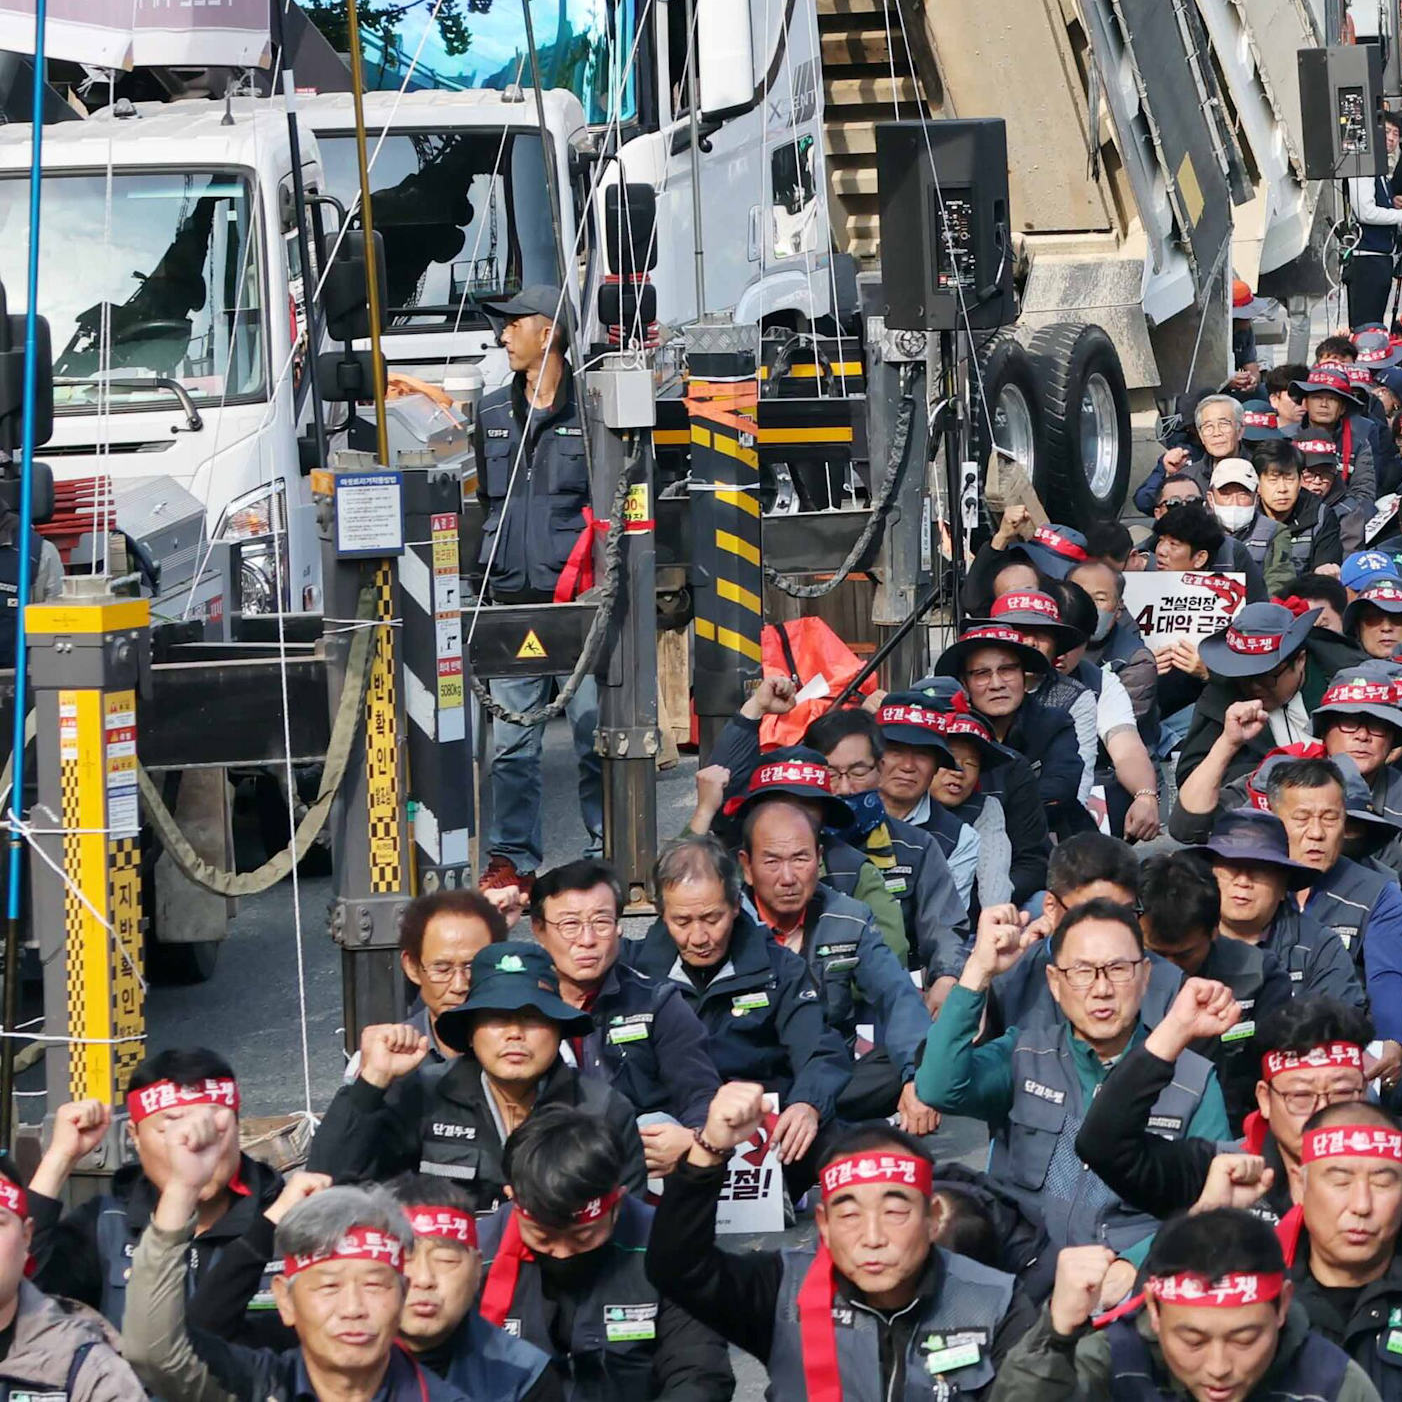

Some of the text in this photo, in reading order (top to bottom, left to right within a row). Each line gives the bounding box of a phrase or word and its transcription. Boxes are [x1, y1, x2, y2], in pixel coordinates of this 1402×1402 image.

[1160, 595, 1217, 613] 건설현장
[1246, 634, 1273, 652] 투쟁
[440, 684, 462, 697] 5080kg
[882, 707, 904, 721] 단결
[760, 765, 827, 785] 단결 투쟁
[1267, 1042, 1361, 1074] 단결 투쟁
[140, 1079, 236, 1113] 단결 투쟁
[1023, 1078, 1066, 1105] 단결투쟁
[432, 1121, 477, 1141] 단결투쟁
[1312, 1129, 1343, 1158] 단결
[824, 1158, 917, 1191] 단결 투쟁
[435, 1210, 470, 1241] 투쟁
[364, 1234, 401, 1265] 투쟁
[1207, 1274, 1258, 1304] 투쟁
